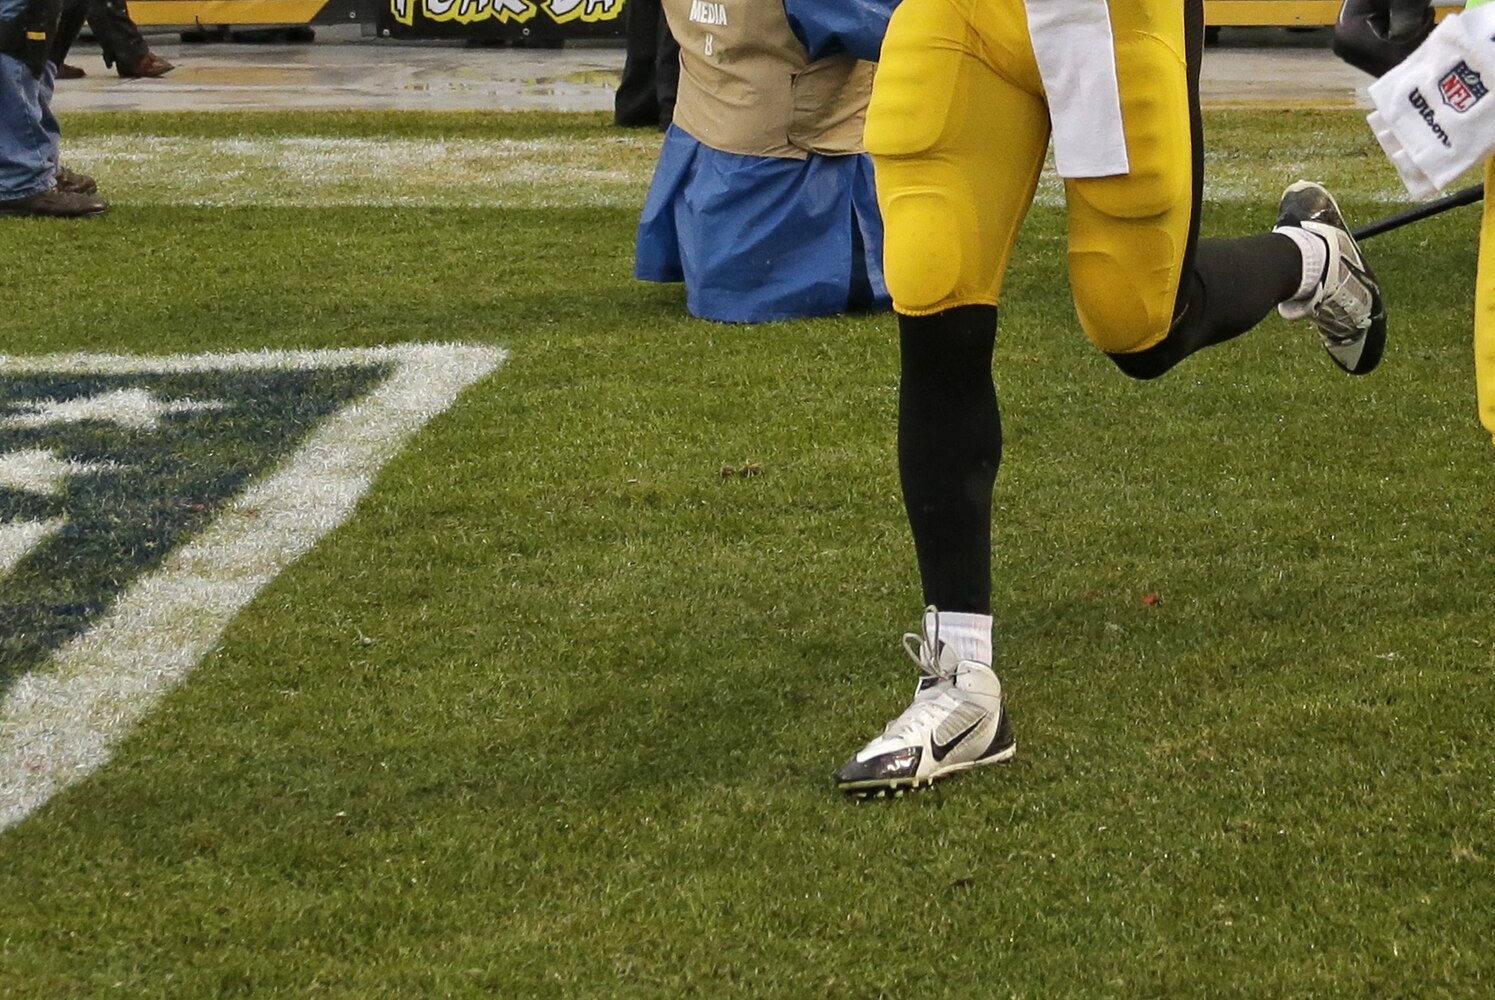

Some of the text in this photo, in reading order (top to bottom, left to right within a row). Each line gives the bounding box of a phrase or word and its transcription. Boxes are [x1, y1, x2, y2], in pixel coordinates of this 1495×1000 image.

[689, 0, 728, 26] MEDIA
[704, 33, 713, 56] 8
[1441, 73, 1472, 111] NFL
[1408, 87, 1452, 148] Wilson
